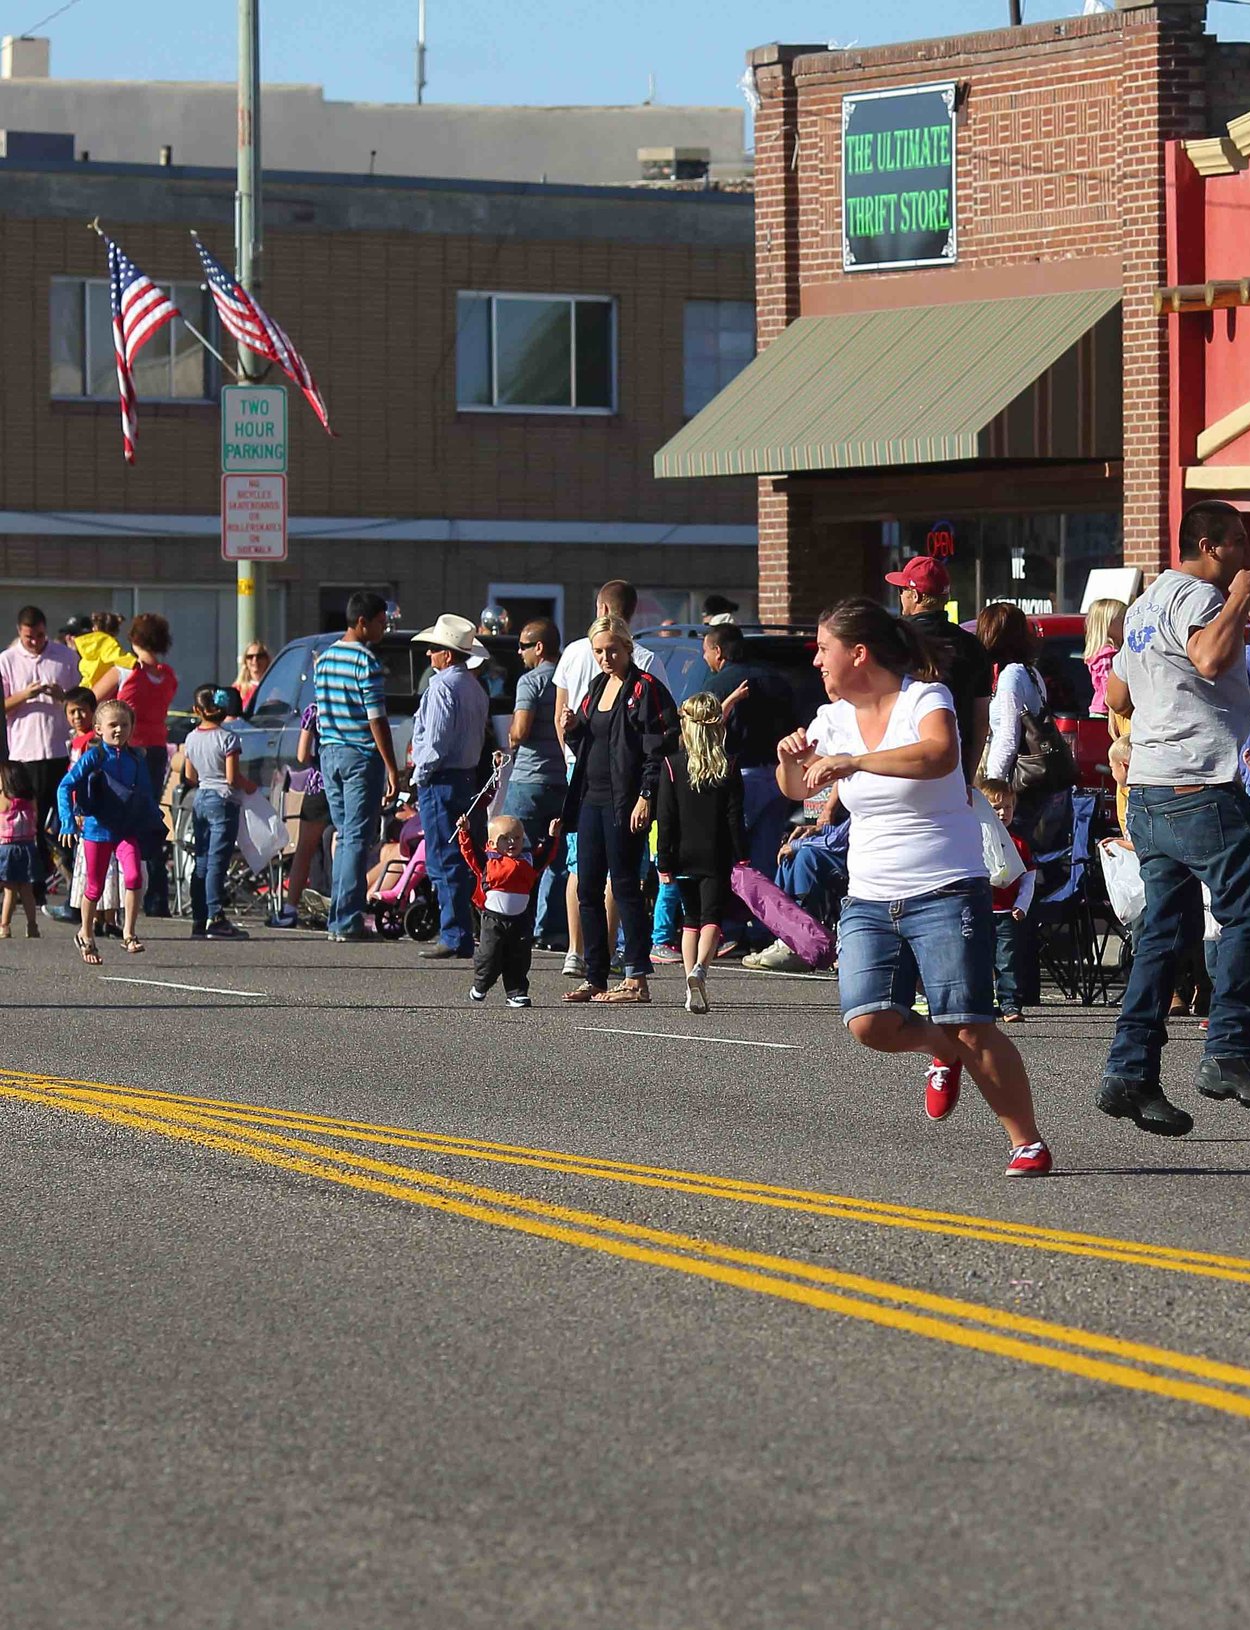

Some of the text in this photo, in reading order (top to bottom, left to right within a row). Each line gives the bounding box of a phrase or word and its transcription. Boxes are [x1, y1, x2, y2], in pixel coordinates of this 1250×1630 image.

[846, 125, 951, 174] THE ULTIMATE
[847, 189, 950, 238] THRIFT STORE
[240, 400, 269, 416] TWO
[235, 422, 274, 437] HOUR
[226, 443, 284, 460] PARKING
[927, 531, 954, 557] OPEN
